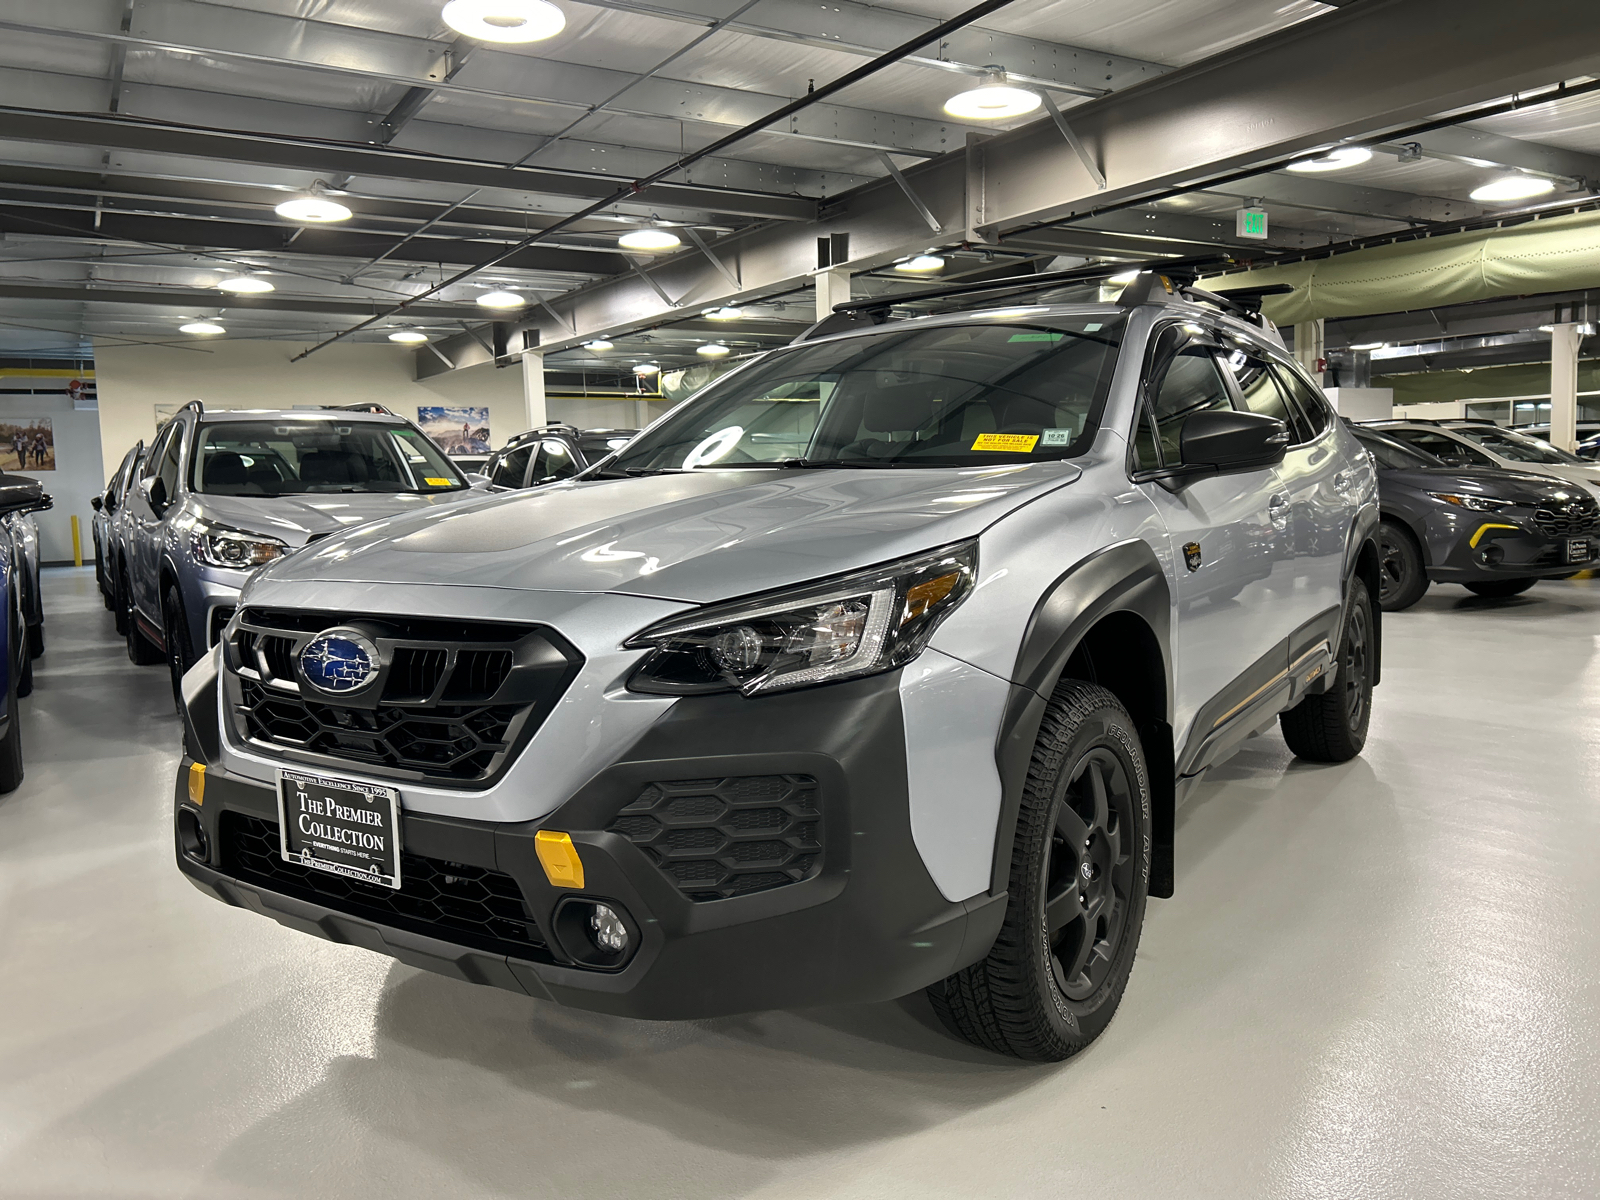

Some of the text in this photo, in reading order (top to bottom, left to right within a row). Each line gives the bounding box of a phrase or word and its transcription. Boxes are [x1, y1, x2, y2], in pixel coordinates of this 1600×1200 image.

[1246, 212, 1264, 234] EXIT
[283, 771, 387, 797] AUTOMOTIVE EXCELLENCE SINCE 1995
[297, 792, 383, 827] THE PREMIER
[1108, 723, 1149, 819] GEOLANDAR
[1141, 835, 1150, 884] A/T
[298, 814, 384, 851] COLLECTION
[312, 841, 340, 853] EVERYTHING
[340, 848, 356, 857] STARTS
